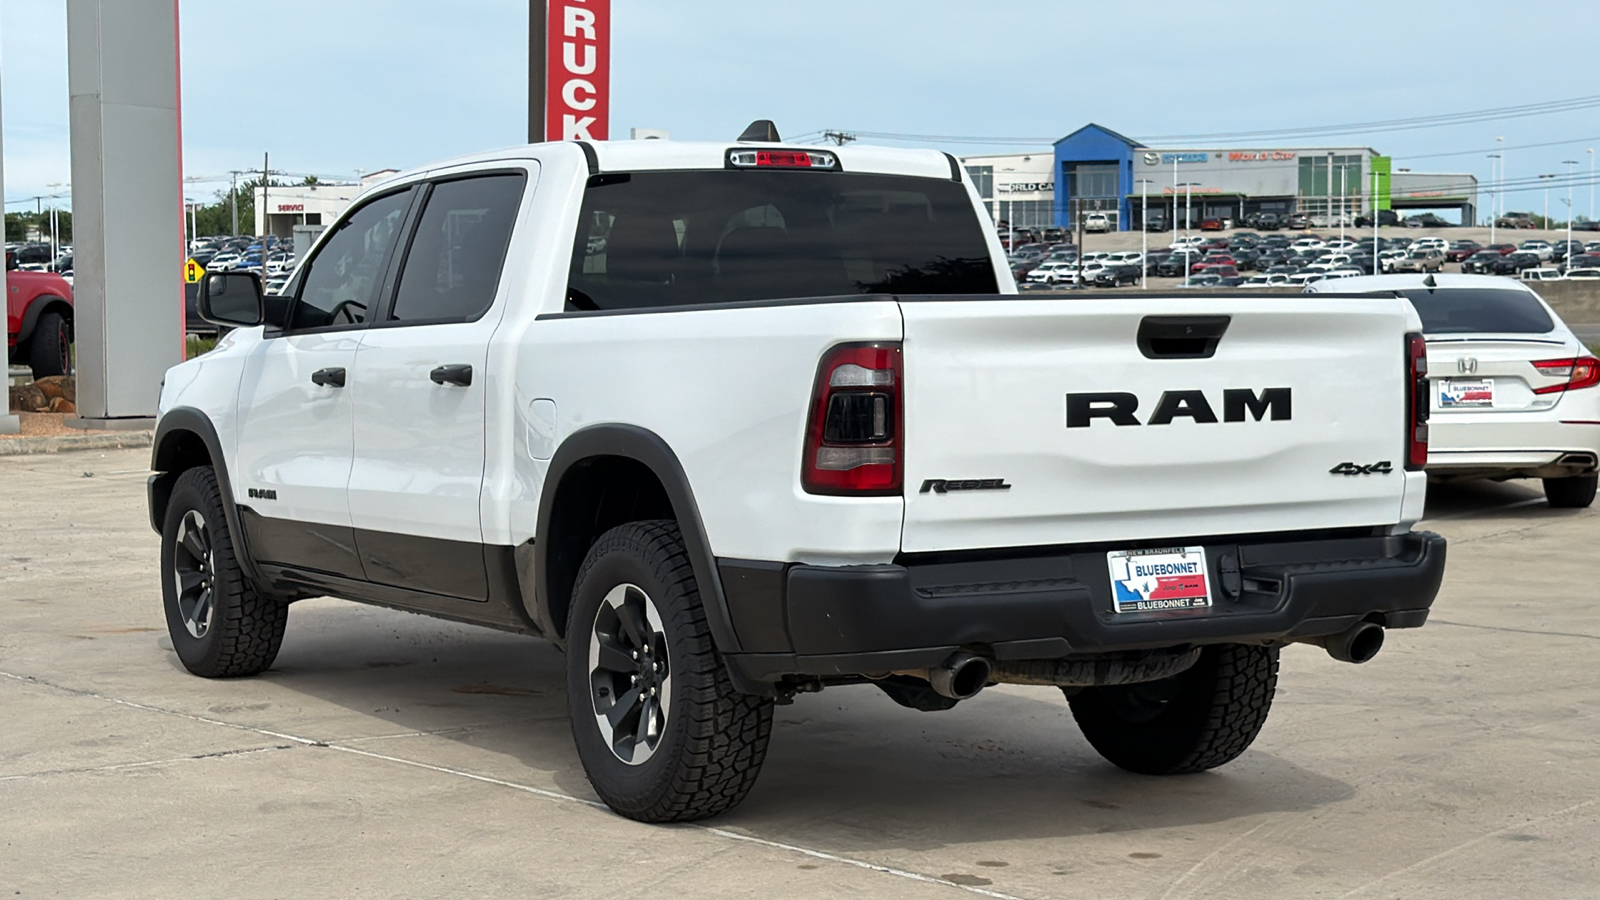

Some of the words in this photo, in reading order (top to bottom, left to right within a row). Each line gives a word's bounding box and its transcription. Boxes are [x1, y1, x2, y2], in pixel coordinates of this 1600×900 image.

[562, 0, 597, 141] RUCK
[997, 183, 1036, 191] ORLD
[1066, 388, 1292, 428] RAM
[1329, 461, 1393, 475] 4x4
[248, 488, 277, 500] RAM
[1136, 562, 1198, 577] BLUEBONNET
[1137, 598, 1190, 610] BLUEBONNET
